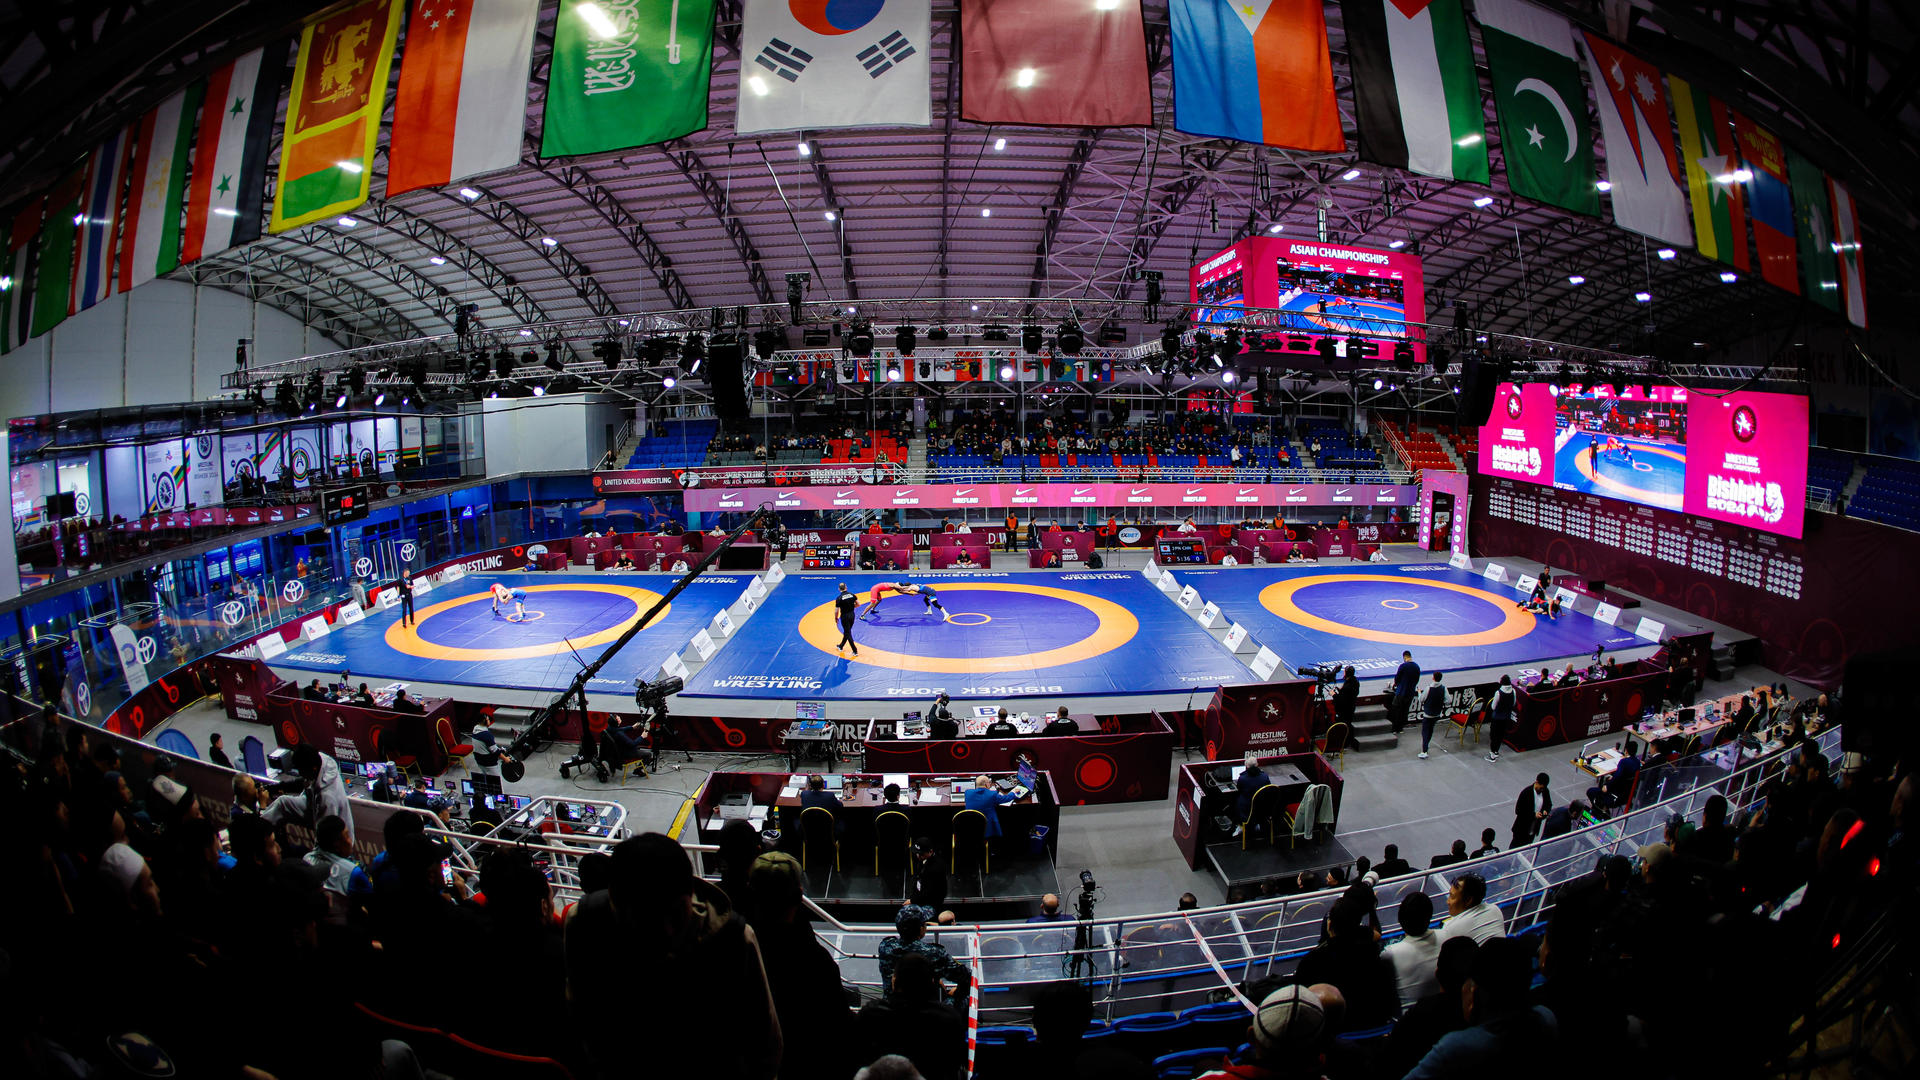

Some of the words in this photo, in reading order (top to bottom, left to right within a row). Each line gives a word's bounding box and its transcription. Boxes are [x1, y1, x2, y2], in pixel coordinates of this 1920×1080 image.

[1289, 244, 1318, 256] ASIAN
[1318, 247, 1389, 265] CHAMPIONSHIPS
[604, 478, 623, 486] UNITED
[622, 477, 642, 486] WORLD
[641, 476, 672, 485] WRESTLING
[1707, 474, 1766, 507] Bishkek
[1706, 496, 1747, 516] 2024
[713, 680, 822, 689] WRESTLING
[887, 687, 947, 695] 2024
[961, 685, 1063, 695] BISHKEK
[979, 707, 997, 715] B
[1250, 731, 1287, 740] WRESTLING
